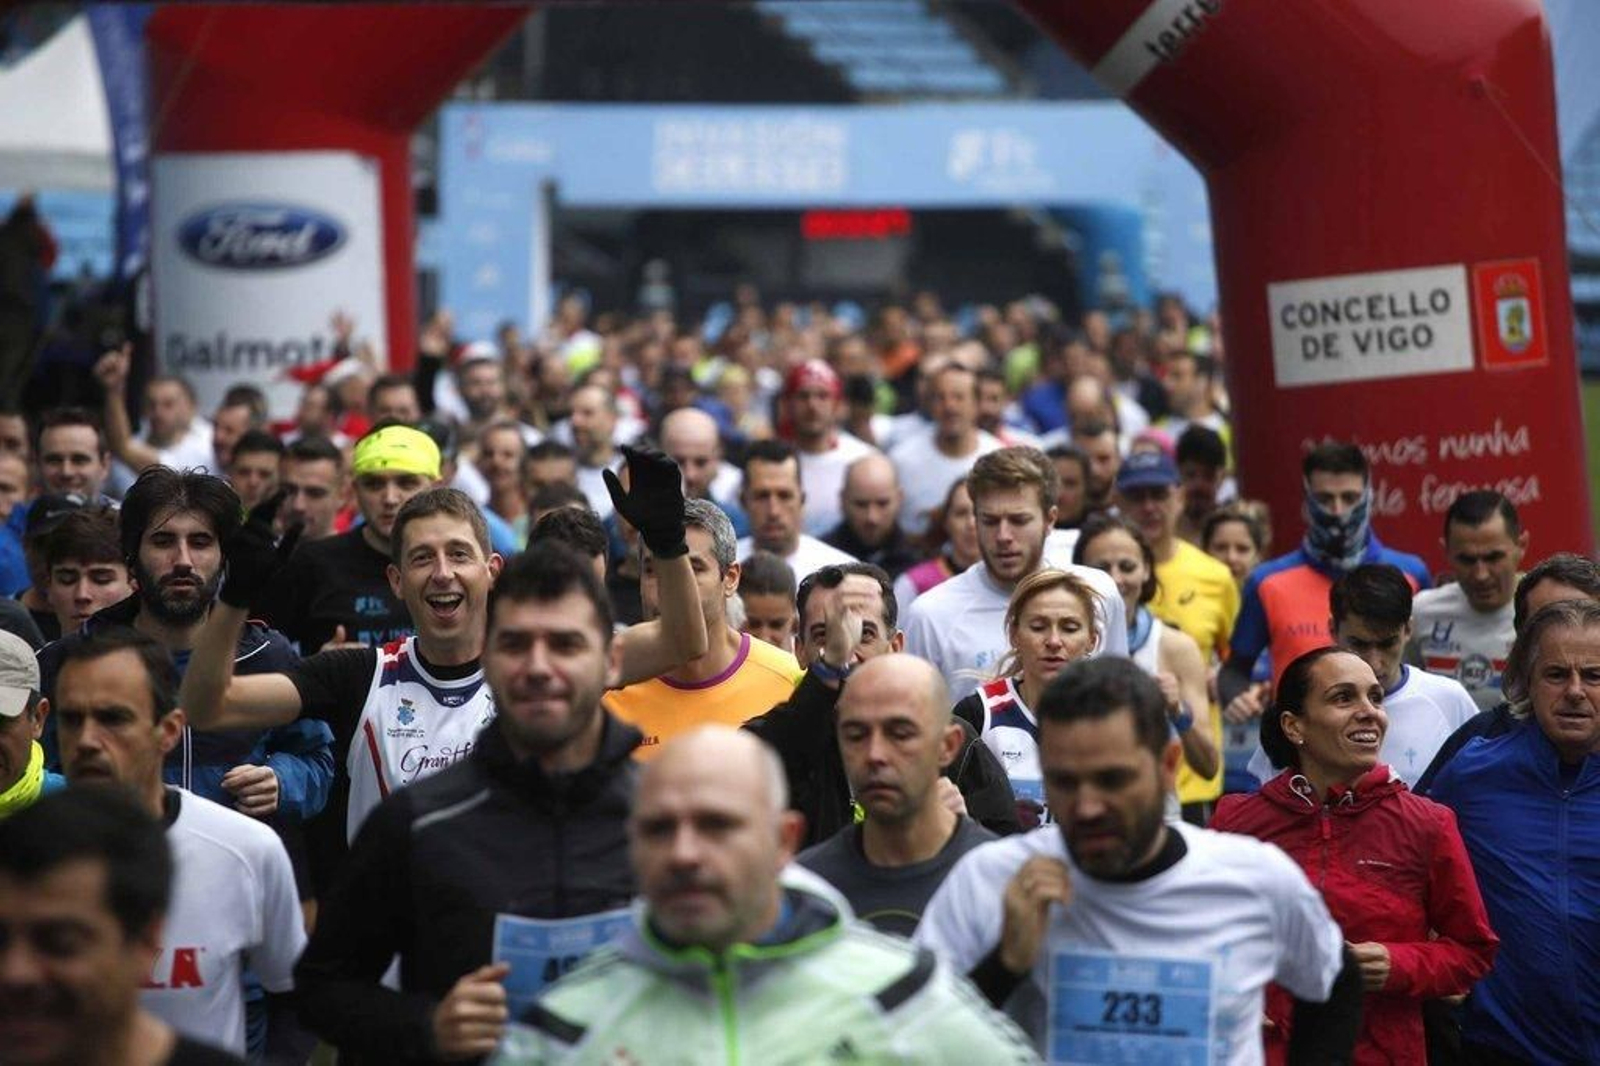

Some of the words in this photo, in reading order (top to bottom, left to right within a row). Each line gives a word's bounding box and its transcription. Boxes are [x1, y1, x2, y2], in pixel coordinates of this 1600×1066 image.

[201, 208, 319, 260] Ford
[1280, 288, 1451, 331] CONCELLO
[1301, 332, 1341, 361] DE
[1351, 323, 1434, 356] VIGO
[1439, 418, 1530, 461] nunha
[1101, 991, 1164, 1026] 233
